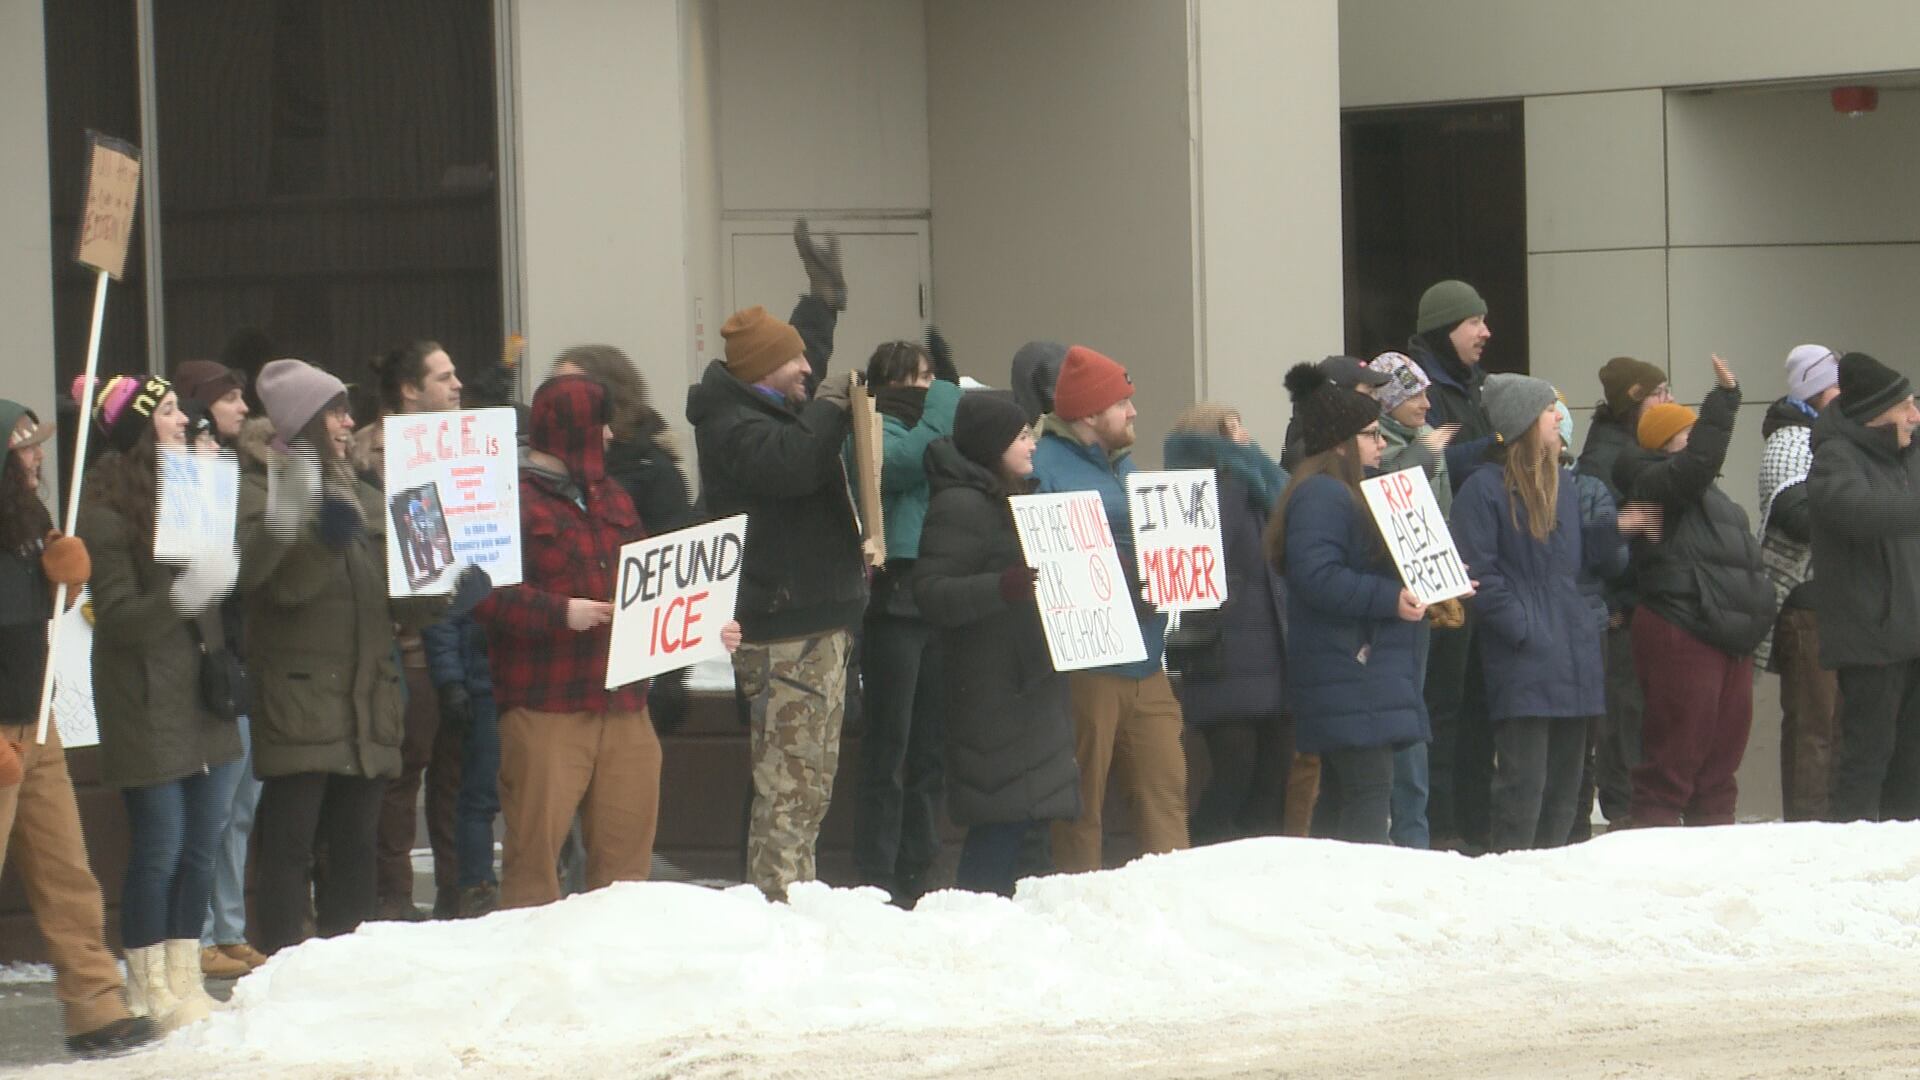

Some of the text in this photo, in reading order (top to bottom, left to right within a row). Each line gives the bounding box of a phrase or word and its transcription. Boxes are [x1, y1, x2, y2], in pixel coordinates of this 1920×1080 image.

[1135, 480, 1217, 532] IT WAS
[1379, 472, 1413, 513] RIP
[1064, 497, 1112, 552] KILLING
[1391, 505, 1439, 559] ALEX
[621, 533, 743, 610] DEFUND
[1142, 544, 1220, 606] MURDER
[1403, 548, 1466, 601] PRETTI
[650, 591, 709, 656] ICE
[1046, 606, 1125, 665] NEIGHBORS
